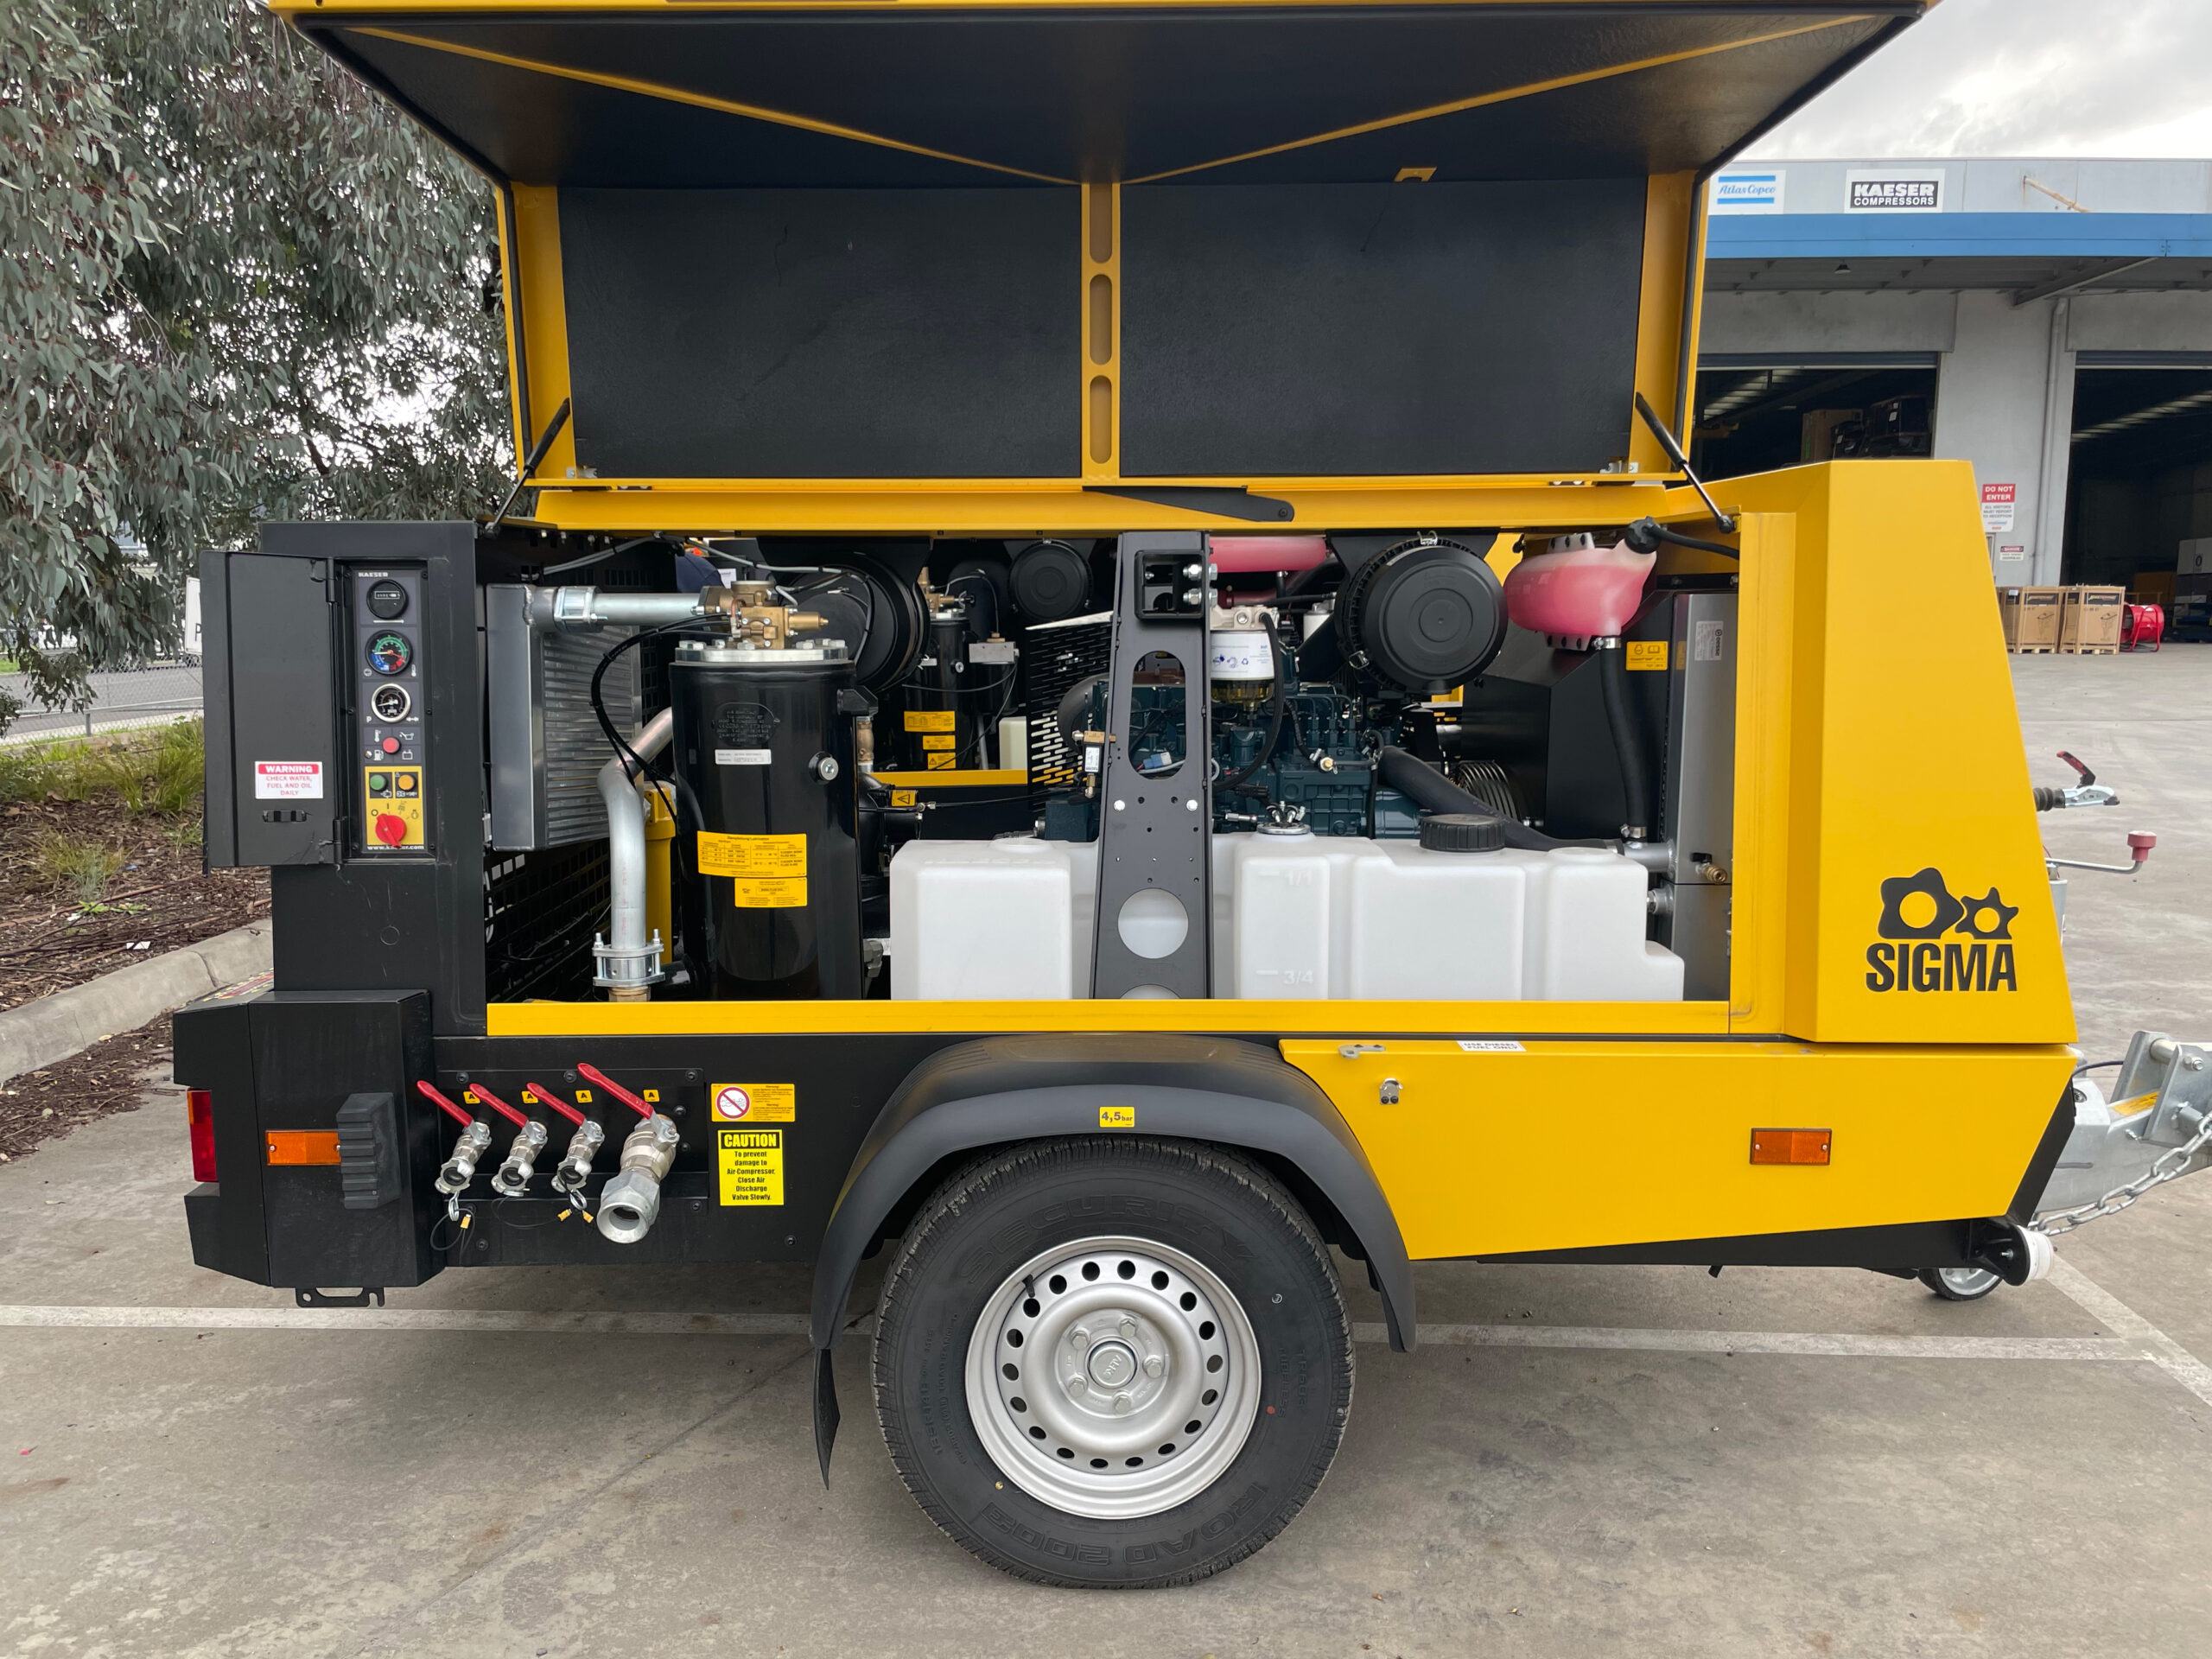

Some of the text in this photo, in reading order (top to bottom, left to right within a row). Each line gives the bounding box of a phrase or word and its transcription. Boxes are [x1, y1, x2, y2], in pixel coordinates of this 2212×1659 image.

[1719, 184, 1776, 195] Atlas Copco
[1854, 183, 1935, 197] KAESER
[1853, 196, 1935, 207] COMPRESSORS
[1866, 943, 2018, 992] SIGMA
[724, 1134, 777, 1147] CAUTION
[958, 1194, 1258, 1284] SECURITY
[1122, 1481, 1268, 1567] ROAD
